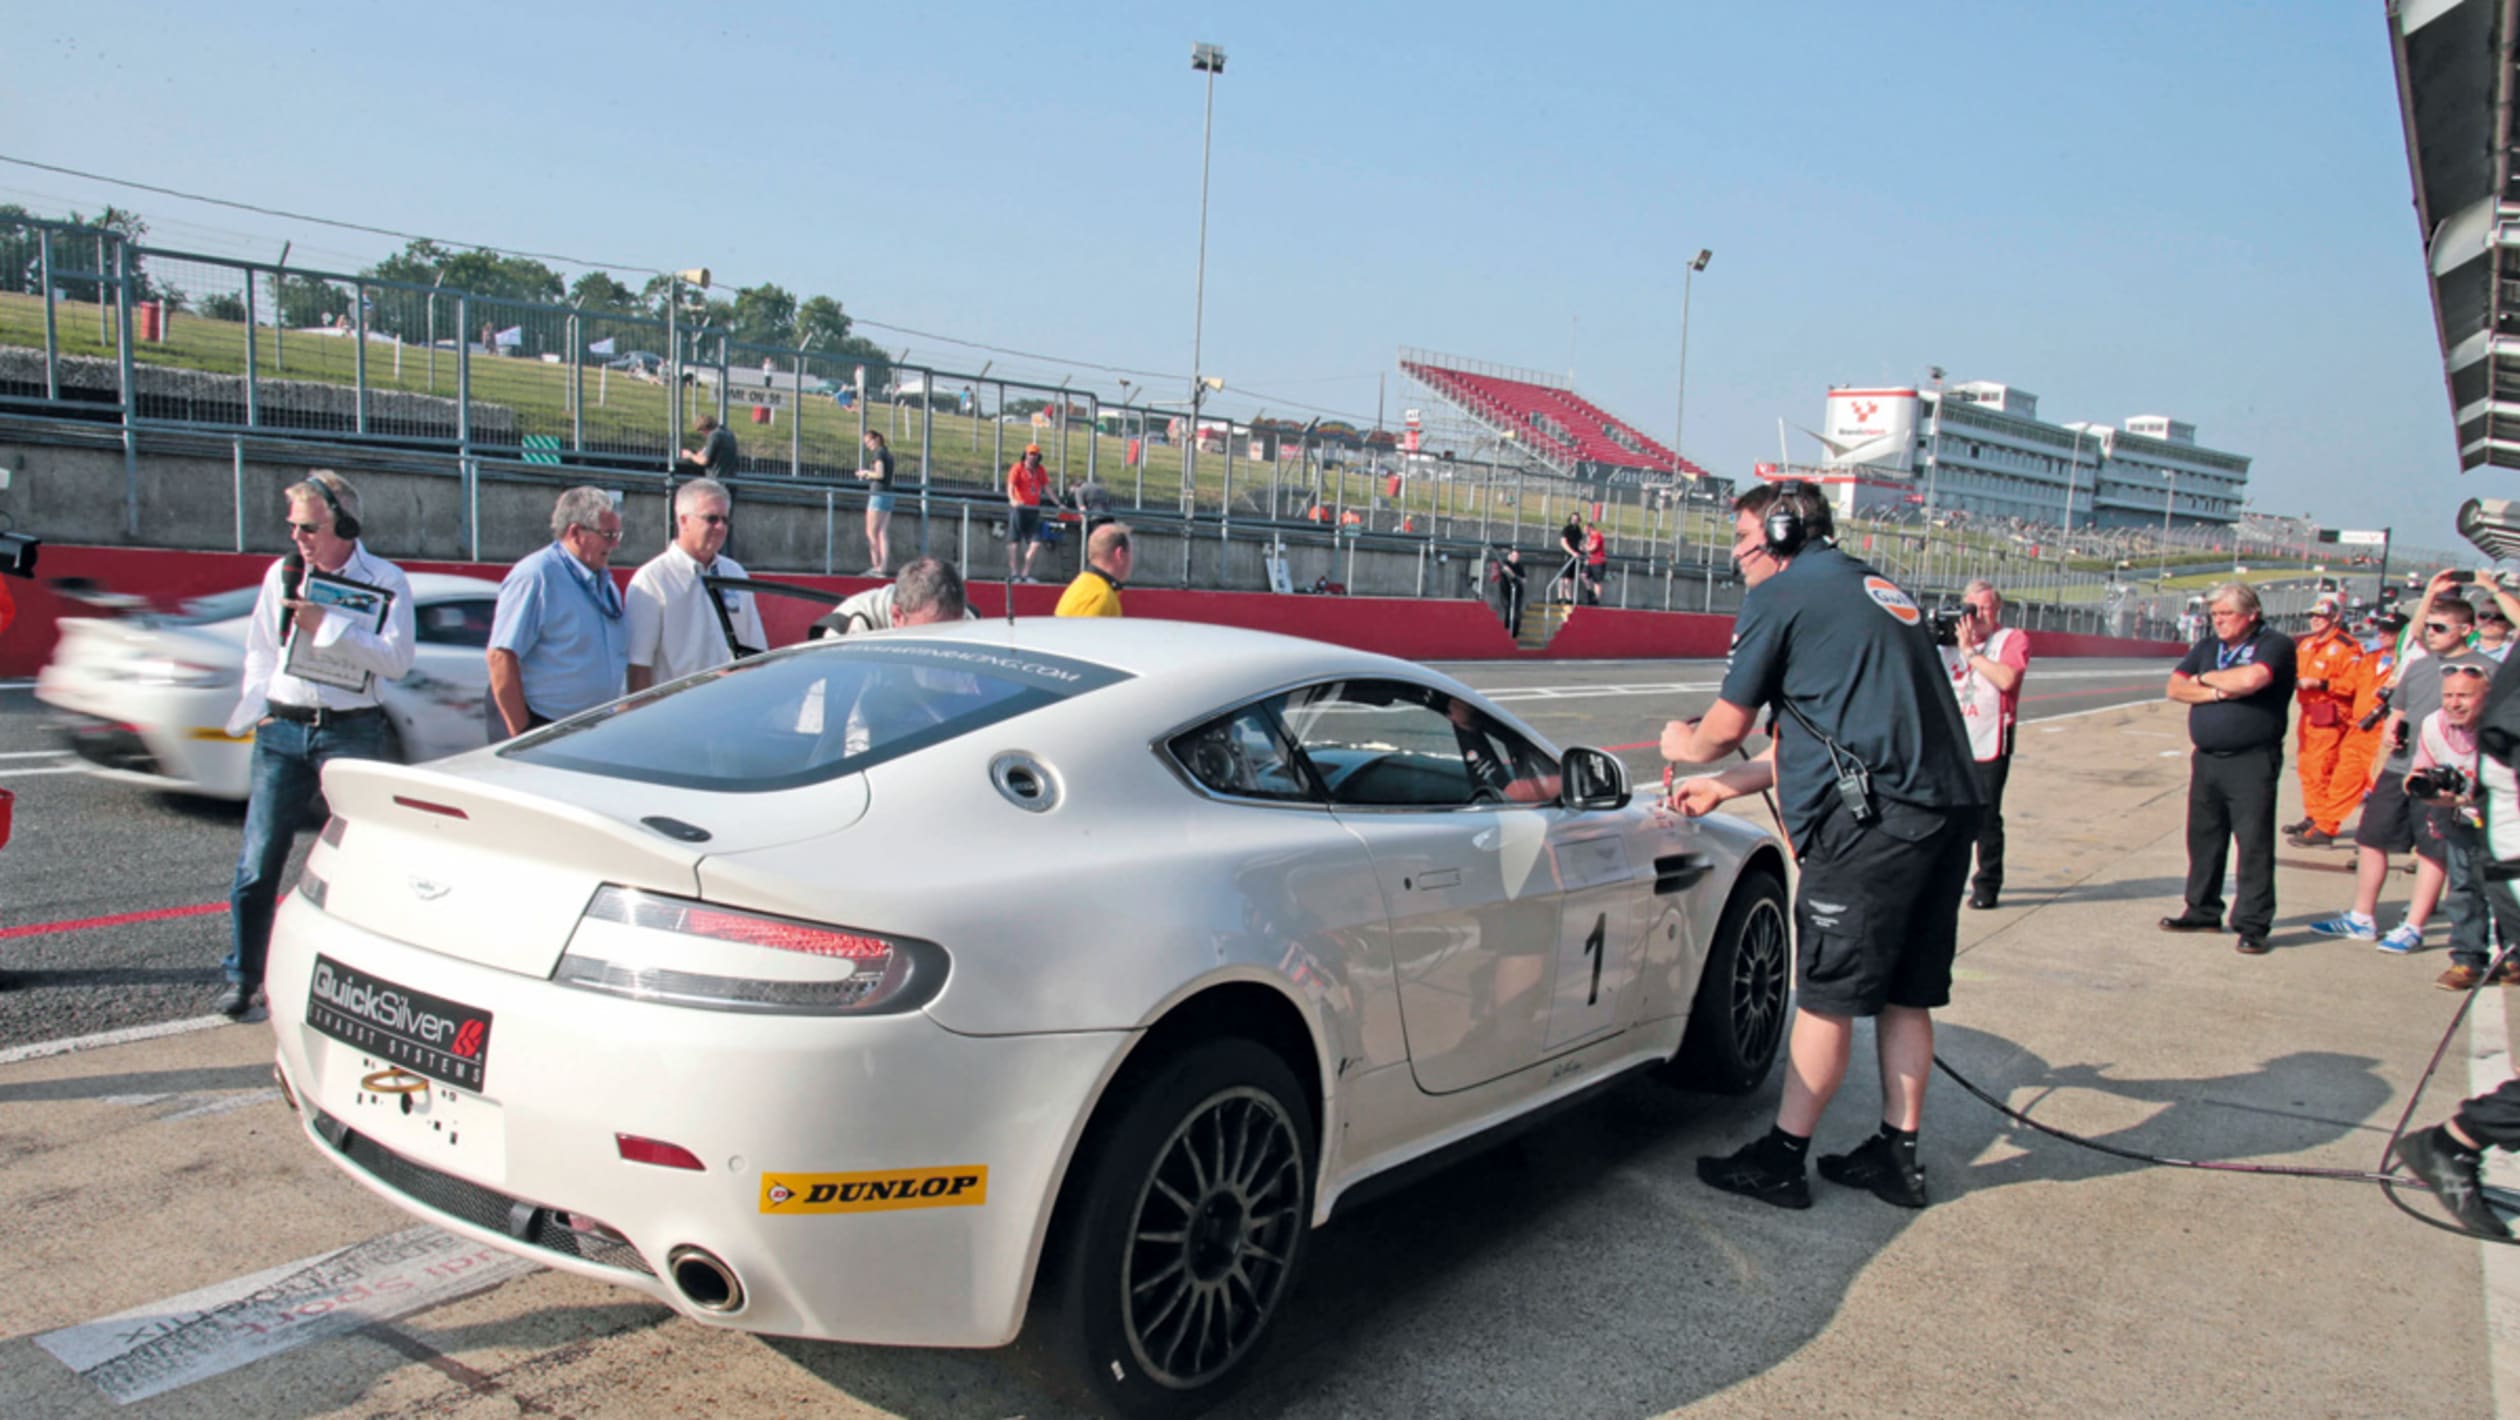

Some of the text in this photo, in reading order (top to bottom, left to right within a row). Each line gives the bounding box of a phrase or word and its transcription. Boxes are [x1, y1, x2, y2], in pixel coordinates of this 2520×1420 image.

[1583, 911, 1606, 1007] 1
[309, 1003, 376, 1045] EXHAUST
[313, 963, 456, 1042] QuickSilver
[389, 1040, 480, 1083] SYSTEMS
[803, 1176, 978, 1203] DUNLOP
[234, 1250, 496, 1336] udi Sport
